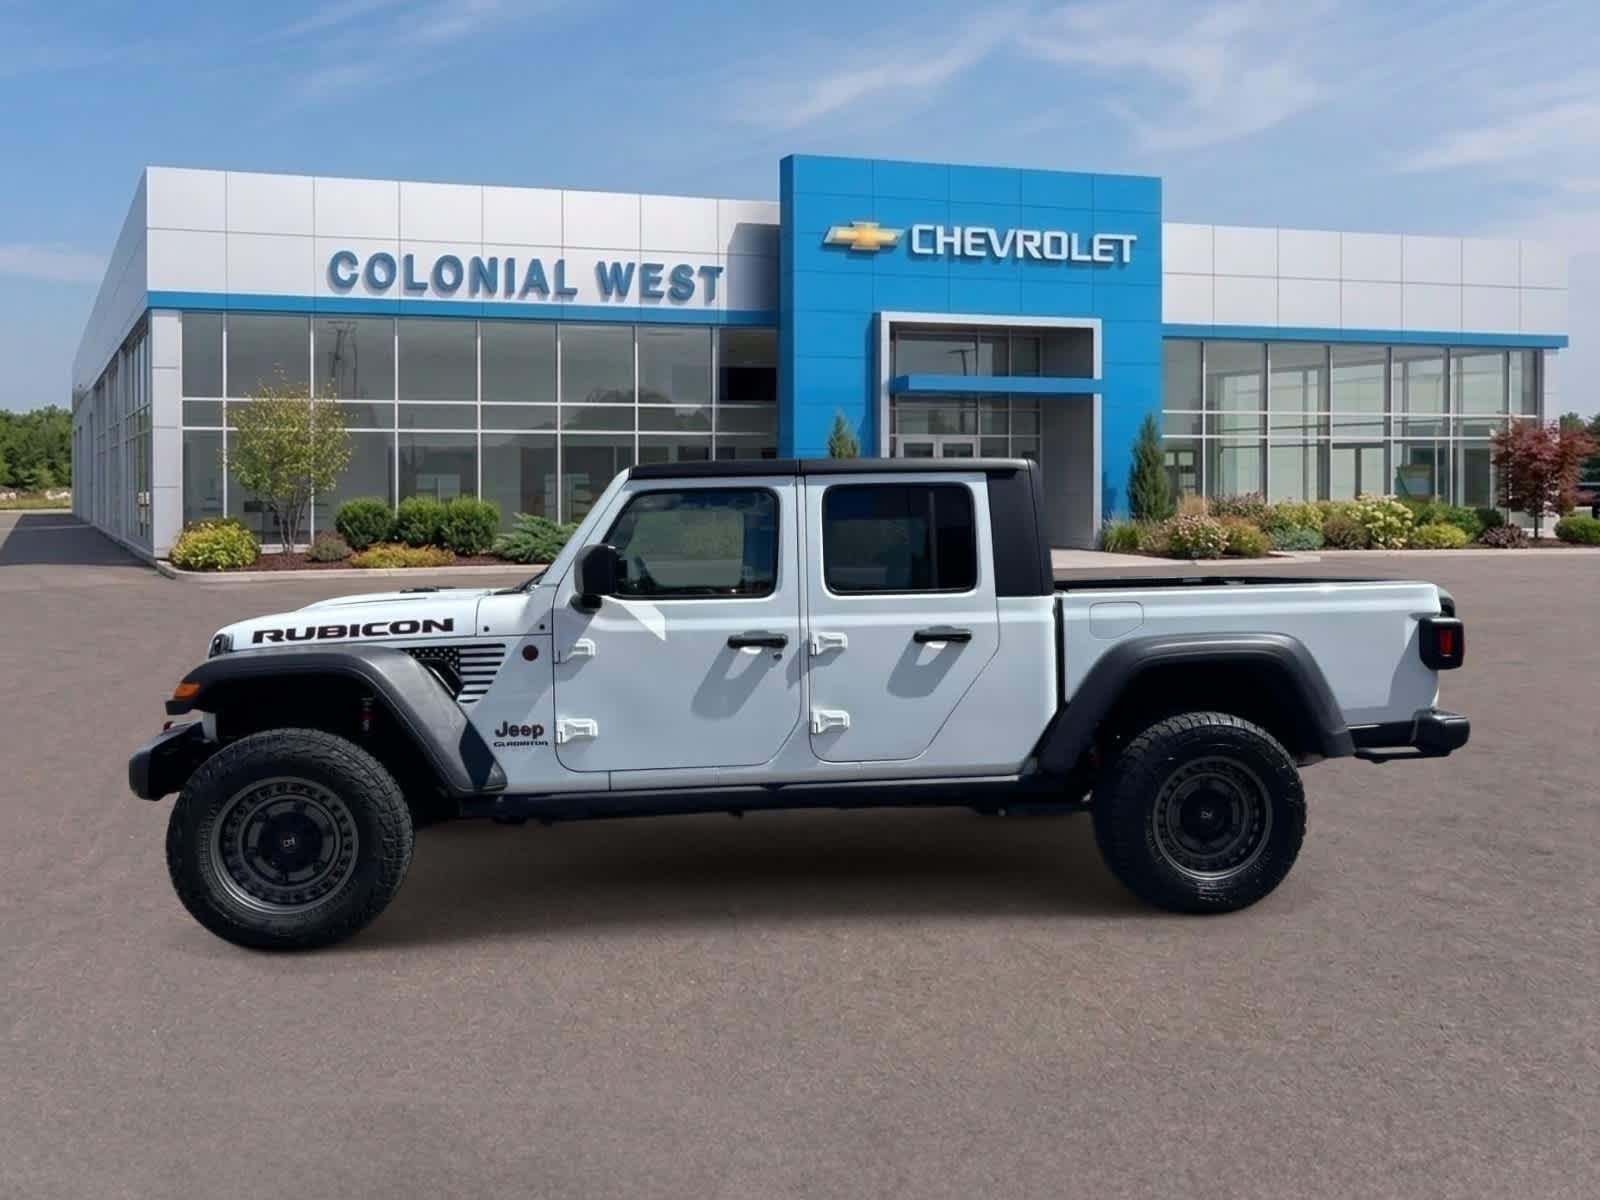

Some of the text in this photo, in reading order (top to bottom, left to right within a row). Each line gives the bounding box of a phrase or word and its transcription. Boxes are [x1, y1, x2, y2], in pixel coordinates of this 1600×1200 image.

[911, 223, 1137, 263] CHEVROLET
[328, 250, 724, 303] COLONIAL WEST
[252, 617, 454, 644] RUBICON
[494, 720, 545, 740] Jeep
